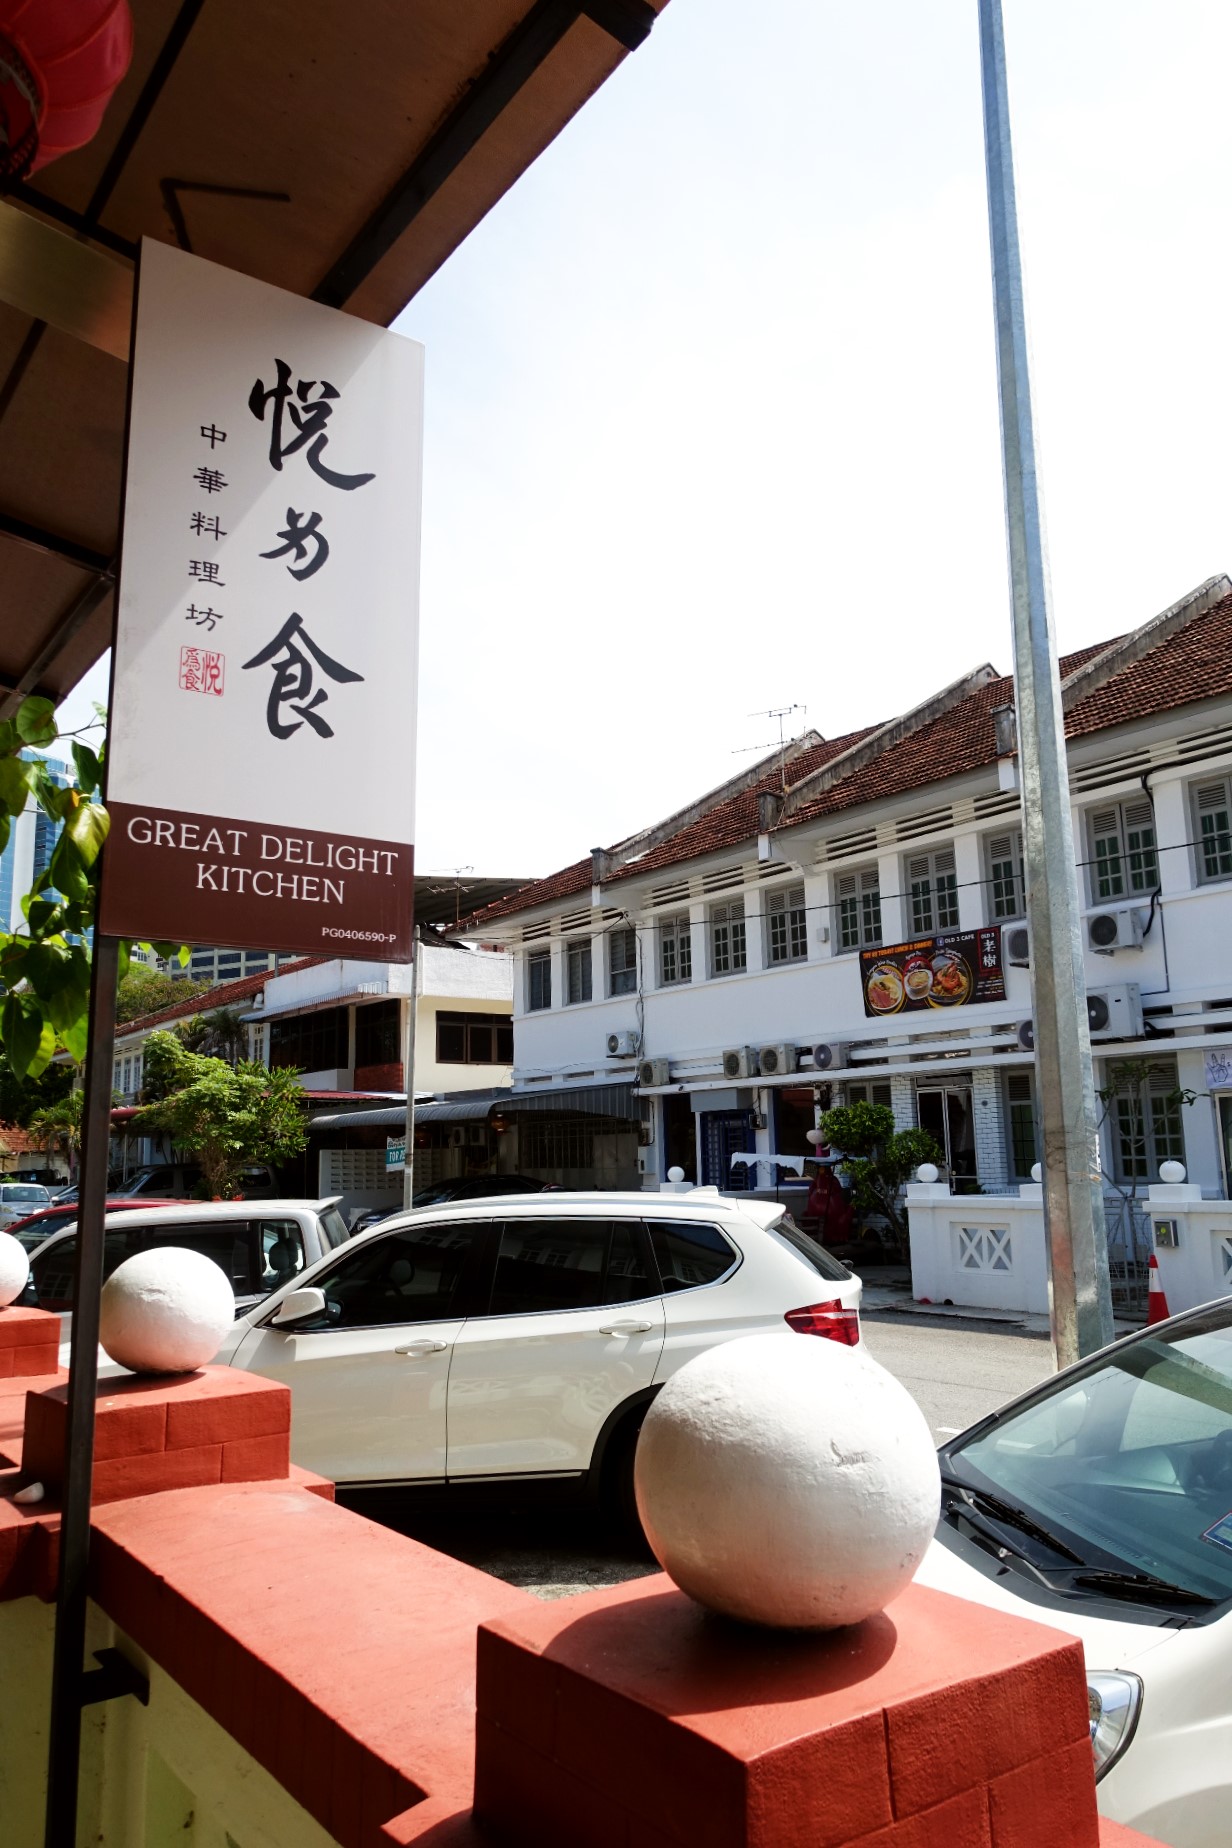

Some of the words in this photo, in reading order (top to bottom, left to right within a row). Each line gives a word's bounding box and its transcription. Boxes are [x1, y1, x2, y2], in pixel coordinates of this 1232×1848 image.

[185, 423, 229, 631] 中華料理坊
[127, 817, 248, 856] GREAT
[260, 834, 399, 876] DELIGHT
[196, 863, 345, 905] KITCHEN
[321, 927, 397, 943] PG0406590-P
[961, 933, 975, 941] CAFE
